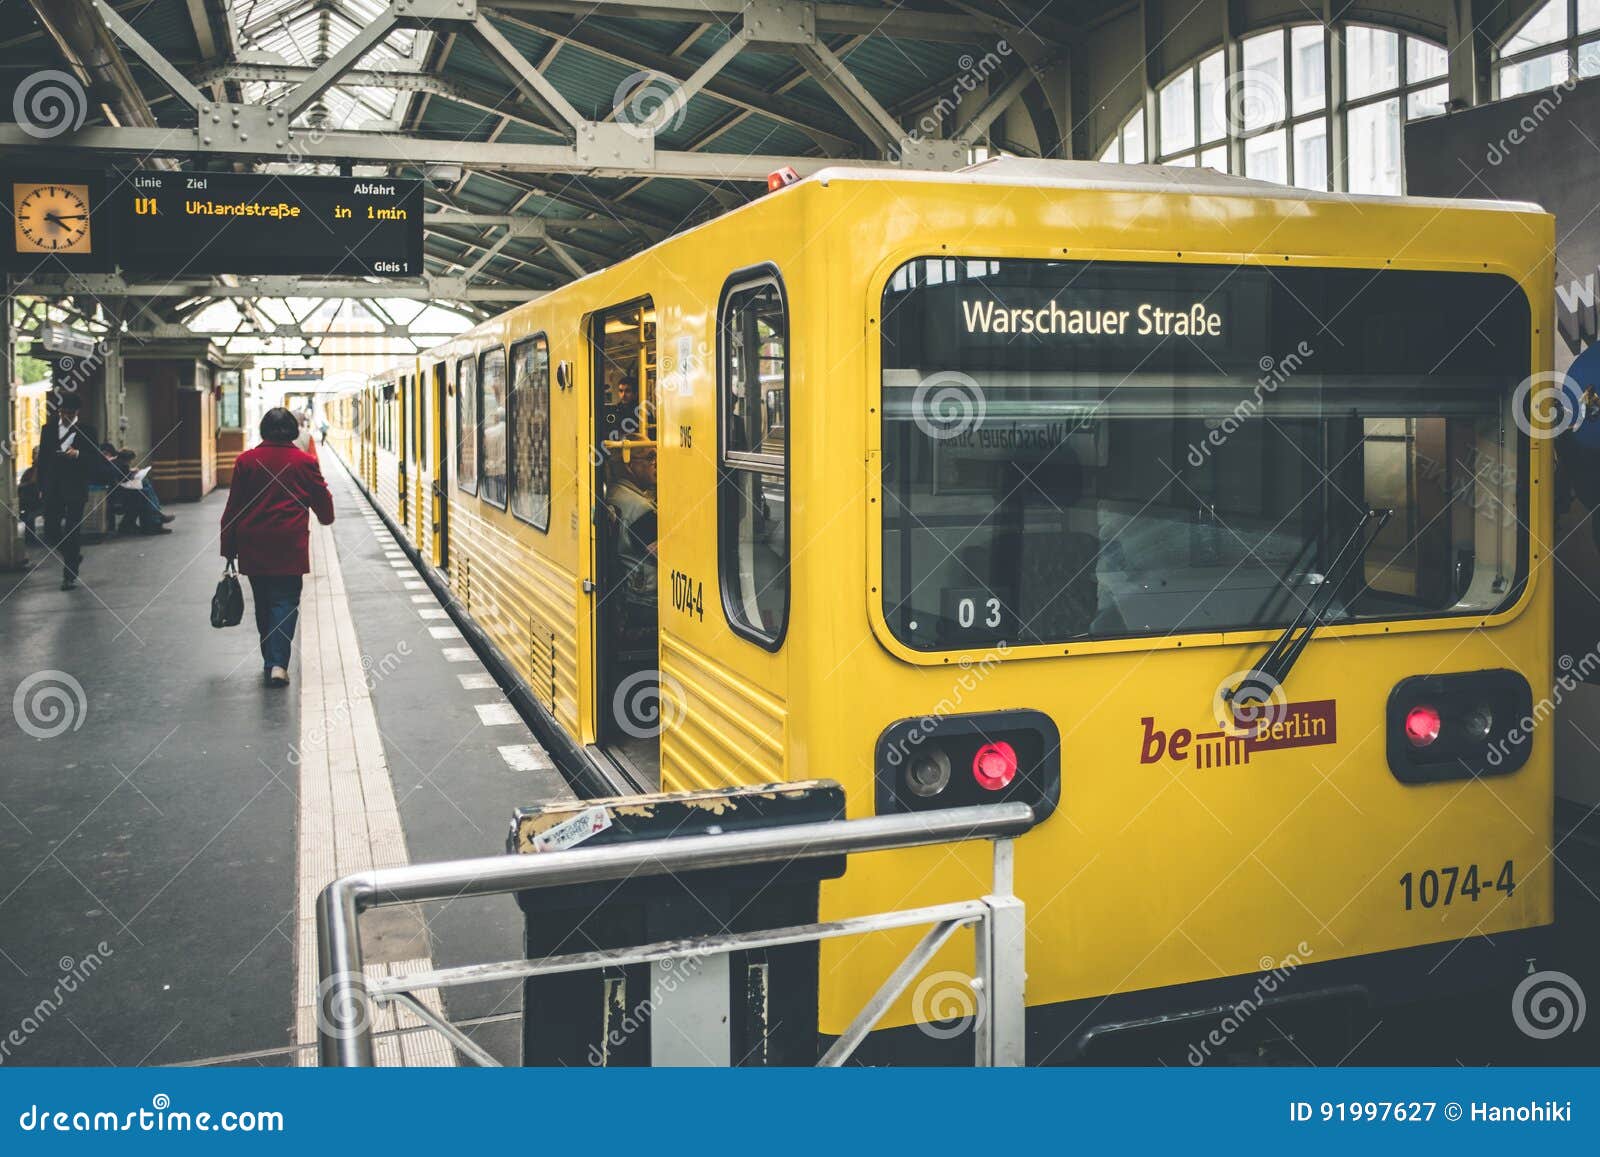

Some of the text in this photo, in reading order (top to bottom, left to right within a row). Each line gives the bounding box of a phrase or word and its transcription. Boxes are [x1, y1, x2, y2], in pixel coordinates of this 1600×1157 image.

[135, 177, 395, 195] Linie Ziel Abfahrt
[135, 198, 157, 215] U1
[186, 201, 301, 219] Uhlandstraße
[334, 205, 352, 218] in
[374, 261, 408, 272] Gleis 1
[1555, 264, 1600, 314] W
[962, 299, 1222, 336] Warschauer Straße
[671, 569, 703, 623] 1074-4
[1140, 713, 1326, 764] be Berlin
[1400, 860, 1516, 911] 1074-4
